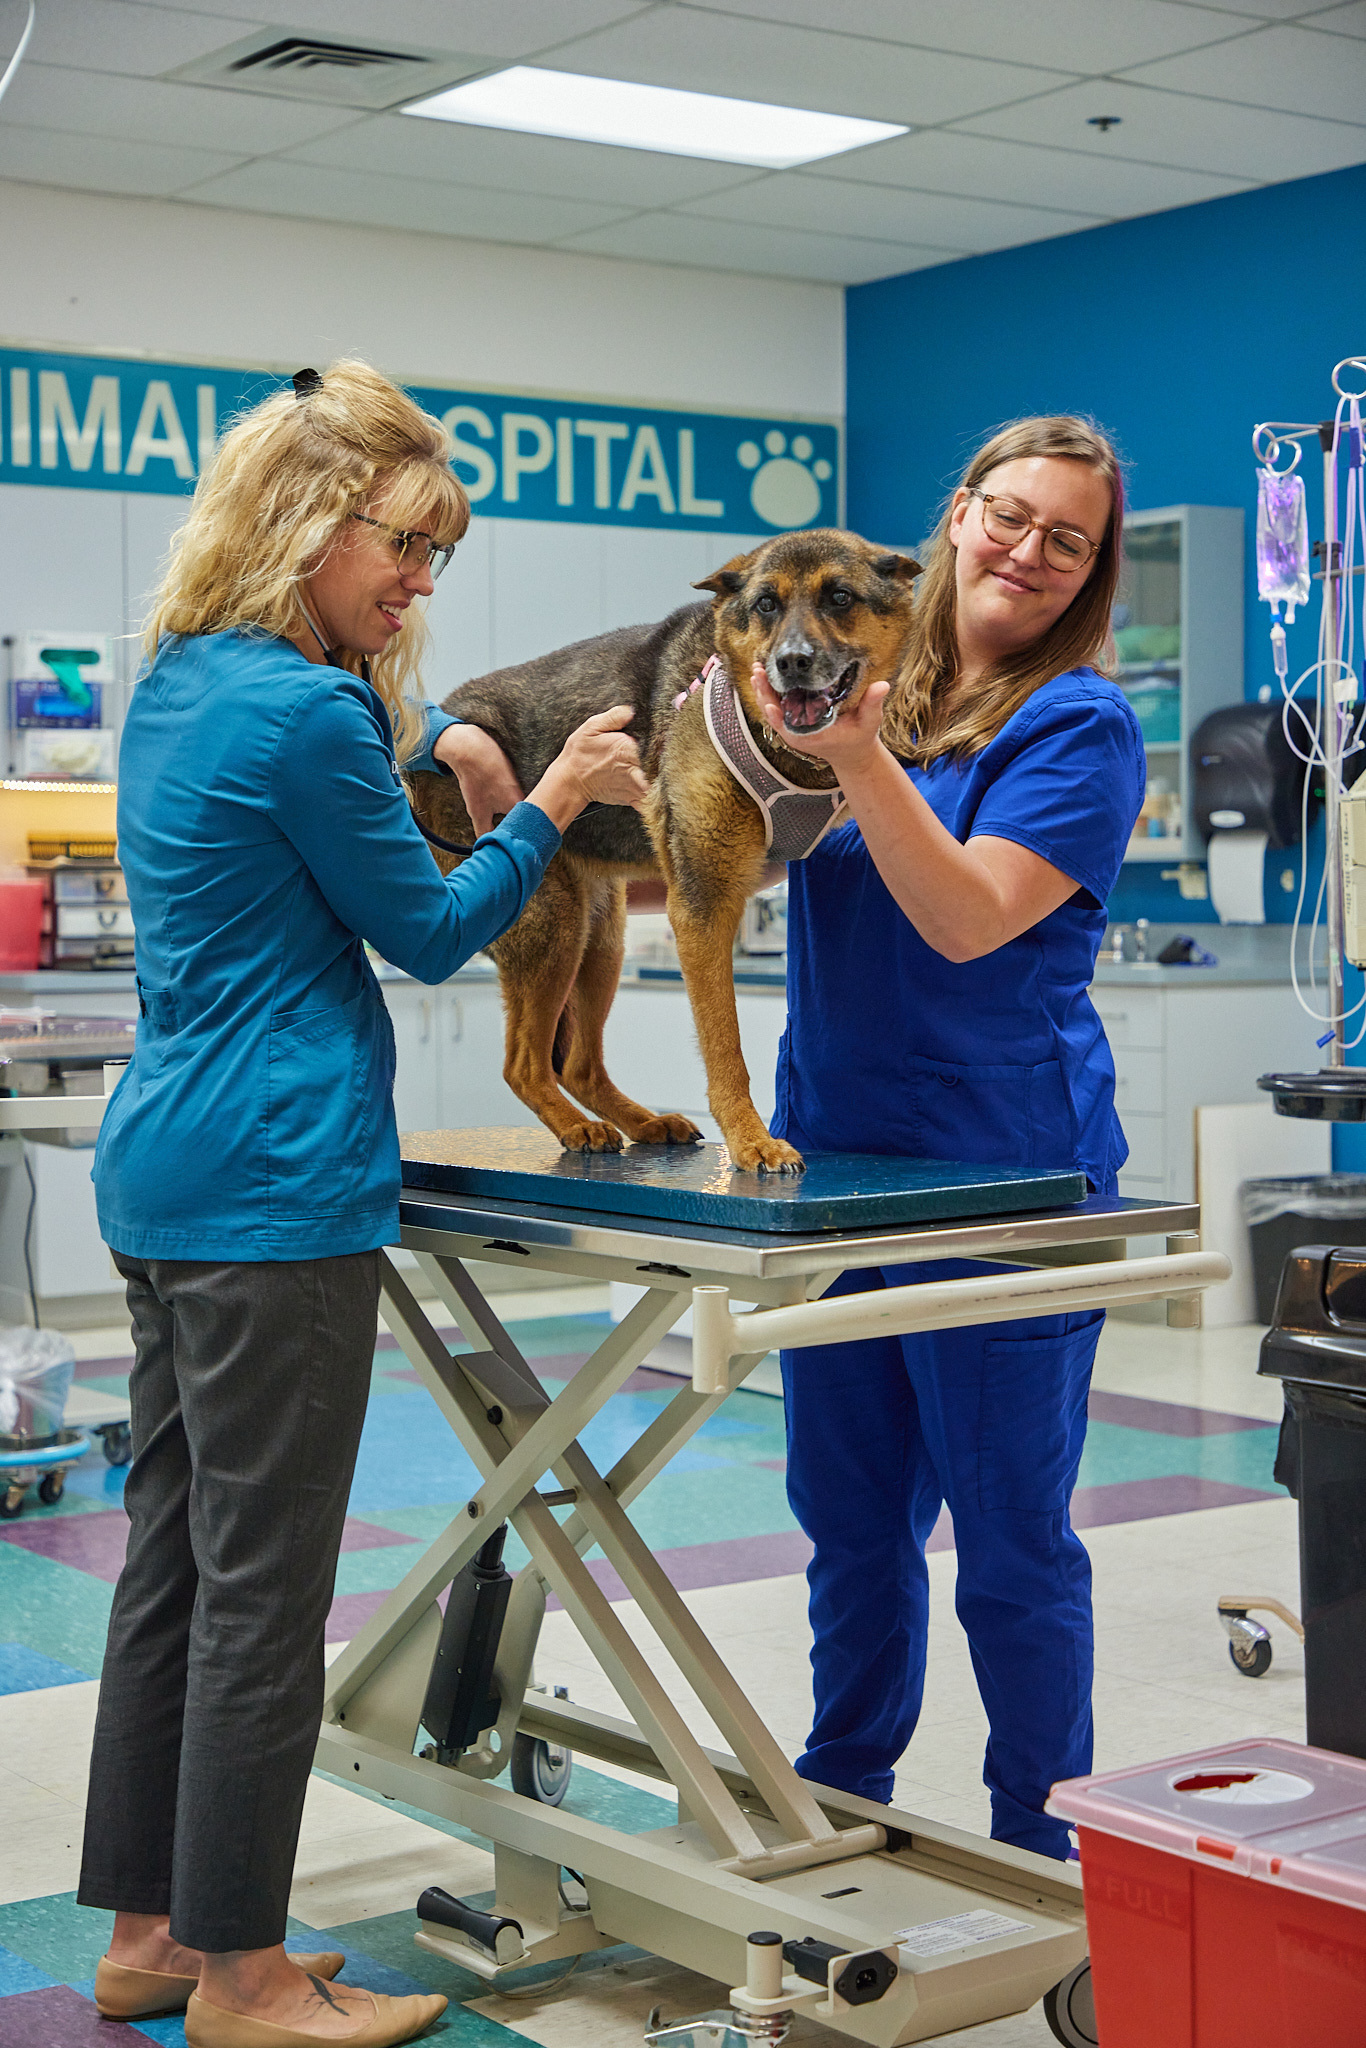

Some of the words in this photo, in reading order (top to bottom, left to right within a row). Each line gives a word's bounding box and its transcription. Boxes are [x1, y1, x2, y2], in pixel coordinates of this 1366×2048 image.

[0, 368, 216, 479] IMAL
[440, 405, 724, 517] SPITAL
[1106, 1875, 1179, 1922] FULL
